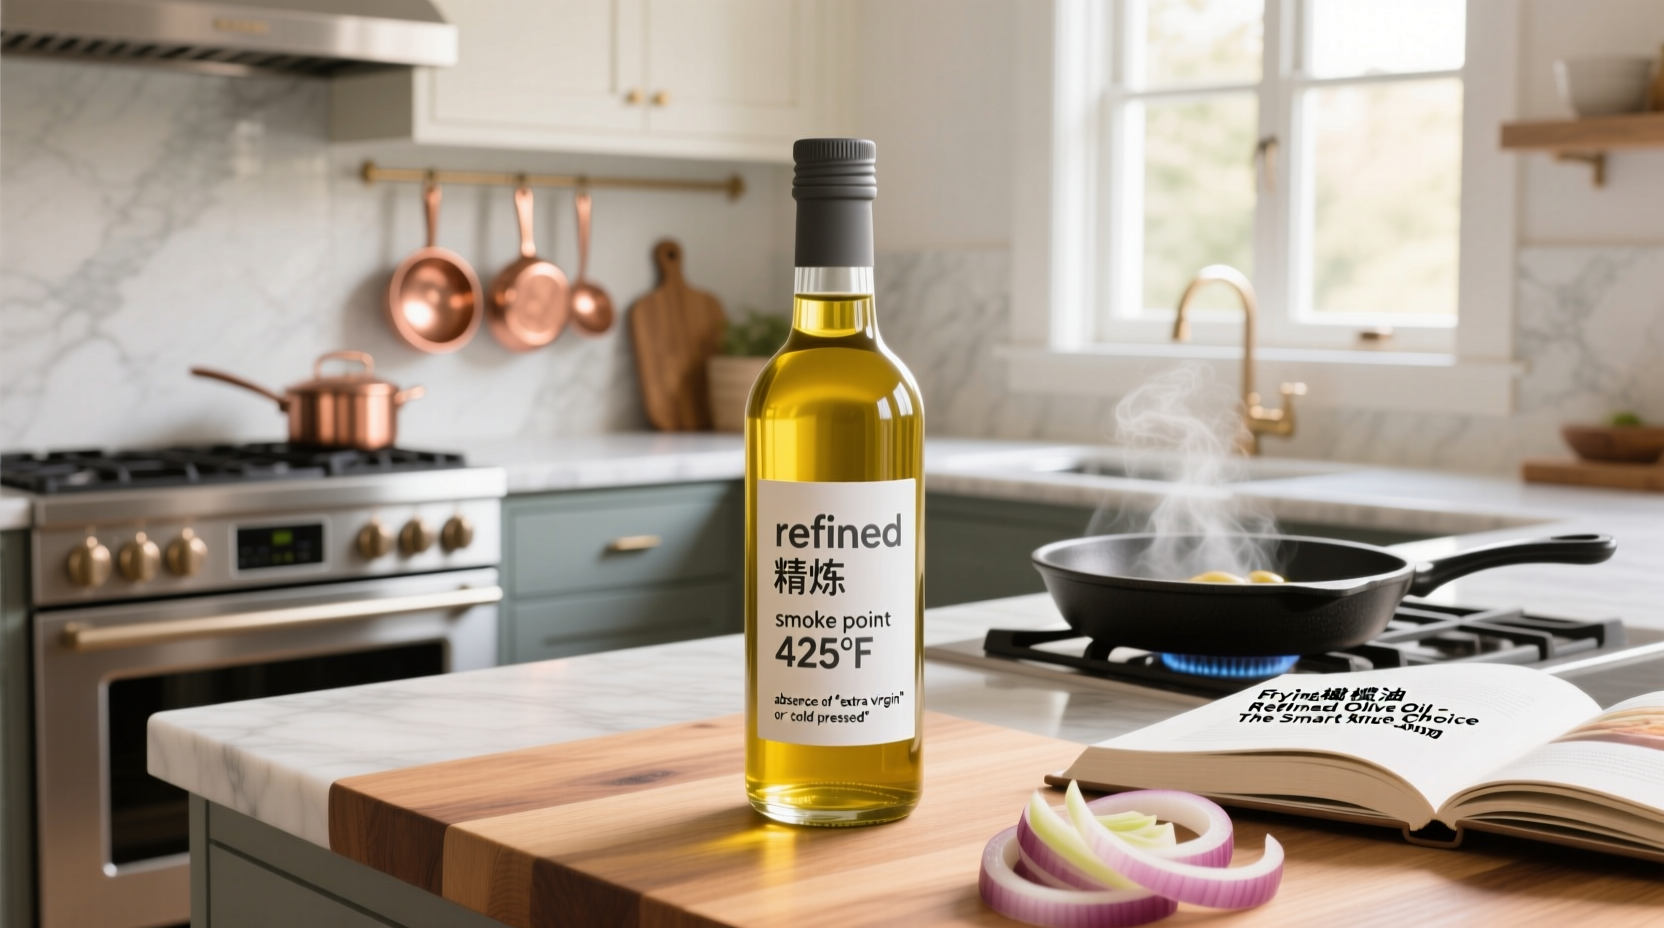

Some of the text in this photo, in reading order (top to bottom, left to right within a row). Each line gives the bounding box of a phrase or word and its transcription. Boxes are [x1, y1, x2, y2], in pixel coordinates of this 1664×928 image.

[775, 512, 902, 549] refined
[773, 556, 846, 597] 精炼
[775, 610, 892, 634] smoke point
[774, 635, 874, 670] 425°F
[774, 692, 819, 707] absence
[821, 695, 833, 707] of
[1344, 701, 1396, 713] Olive
[1400, 702, 1434, 714] Oil
[1239, 713, 1275, 723] The
[1402, 713, 1480, 726] Choice
